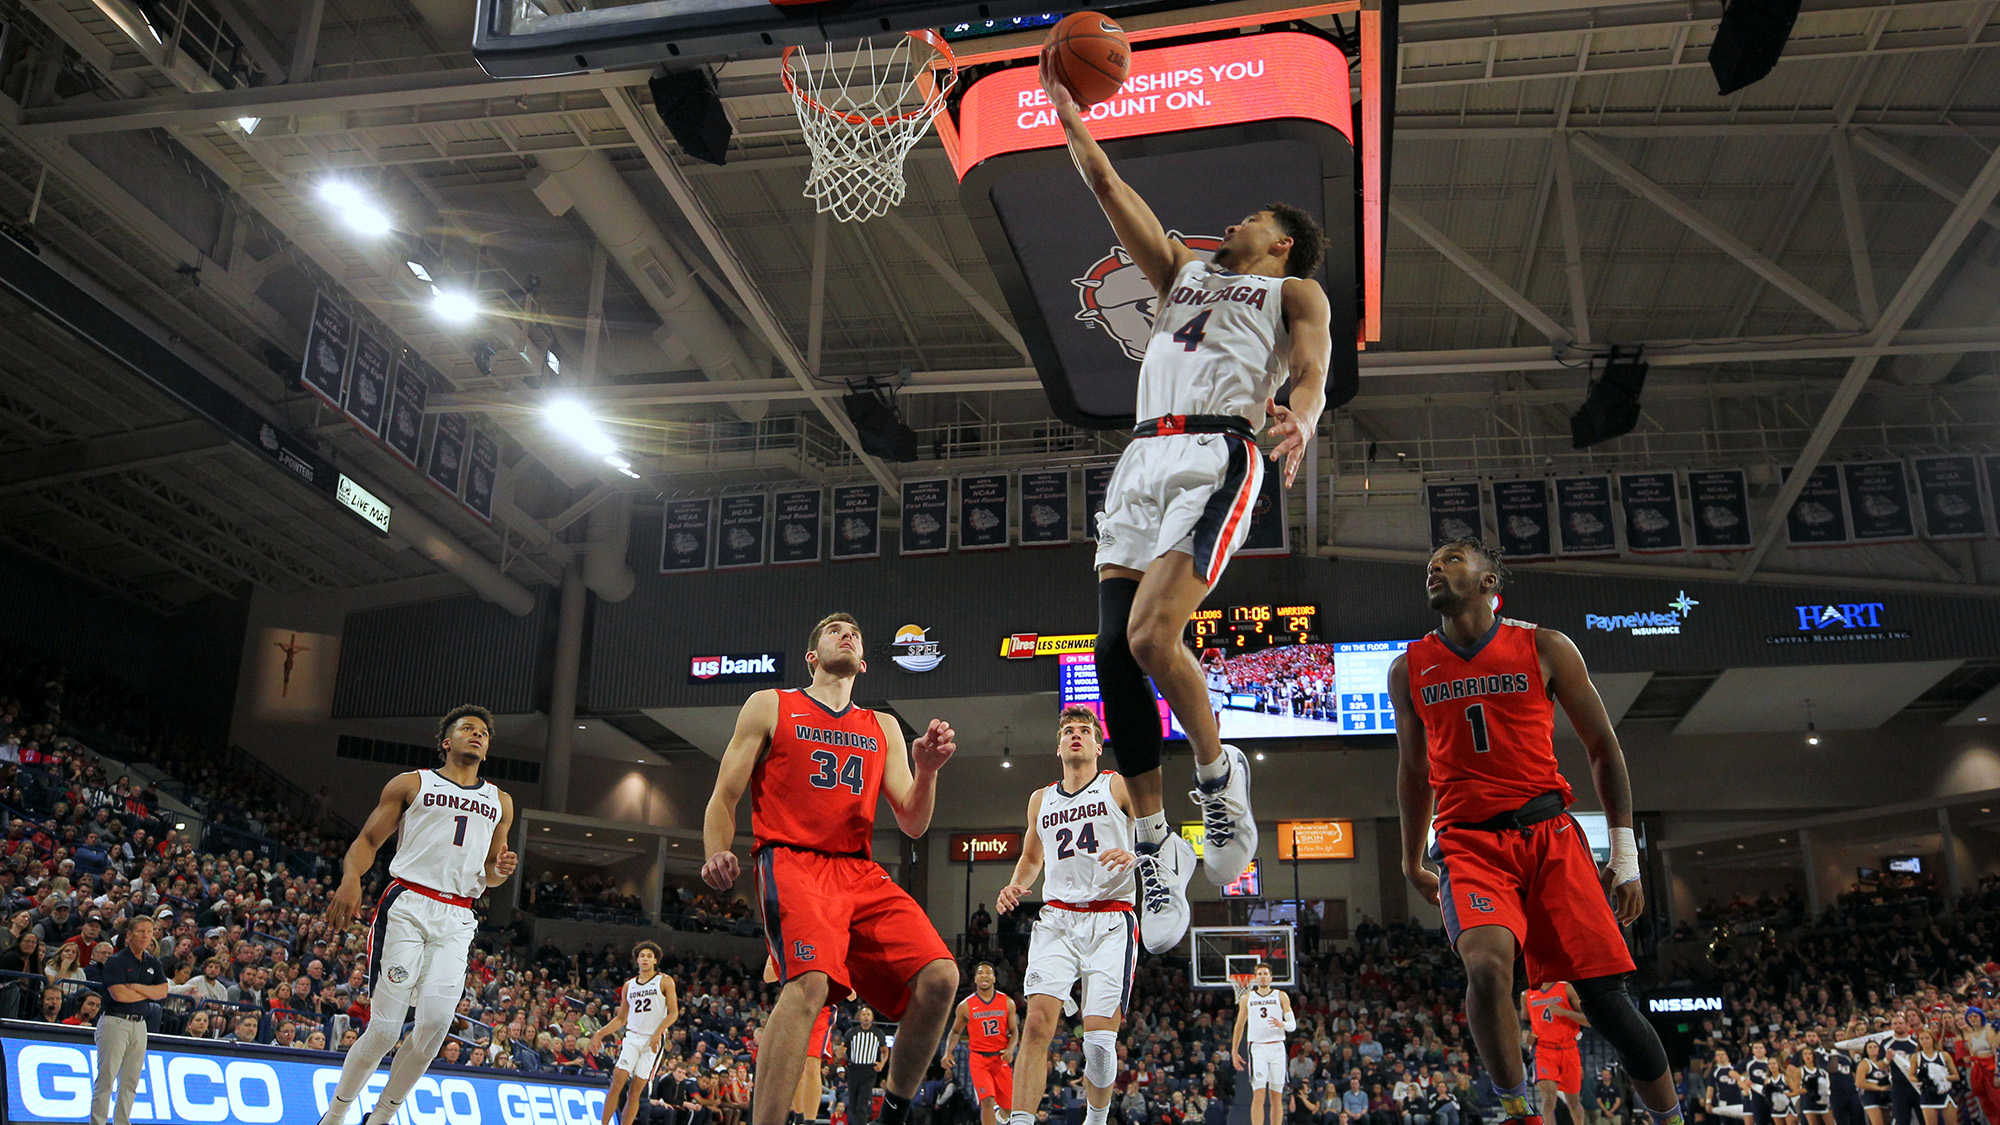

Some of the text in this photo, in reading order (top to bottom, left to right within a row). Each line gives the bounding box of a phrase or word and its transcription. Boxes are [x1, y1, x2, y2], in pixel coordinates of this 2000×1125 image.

[1018, 60, 1264, 108] RENSHIPS YOU
[1166, 90, 1211, 110] ON.
[1173, 309, 1213, 352] 4
[1190, 606, 1316, 621] ULLDOGS 17:06 WARRIORS
[1586, 611, 1681, 631] PayneWest
[1196, 620, 1216, 635] 67
[1255, 622, 1264, 633] 2
[1289, 616, 1309, 631] 29
[1632, 627, 1680, 636] INSURANCE
[1012, 636, 1095, 652] Tires LES SCHWAB
[1196, 637, 1204, 648] 3
[1236, 635, 1245, 646] 2
[1268, 634, 1274, 644] 1
[1299, 632, 1308, 644] 2
[1421, 673, 1528, 706] WARRIORS
[1465, 703, 1490, 753] 1
[795, 725, 878, 752] WARRIORS
[810, 750, 864, 794] 34
[424, 793, 497, 822] GONZAGA
[1042, 802, 1108, 829] GONZAGA
[453, 815, 468, 847] 1
[1056, 822, 1099, 860] 24
[1467, 892, 1495, 912] LC
[794, 940, 816, 961] LC
[630, 989, 657, 999] GONZAGA
[635, 998, 651, 1013] 22
[973, 1010, 1005, 1019] WARRIORS
[1260, 1007, 1267, 1018] 3
[1542, 1006, 1553, 1023] 4
[1650, 998, 1722, 1012] NISSAN
[982, 1019, 1000, 1036] 12
[498, 1083, 608, 1125] GEICO
